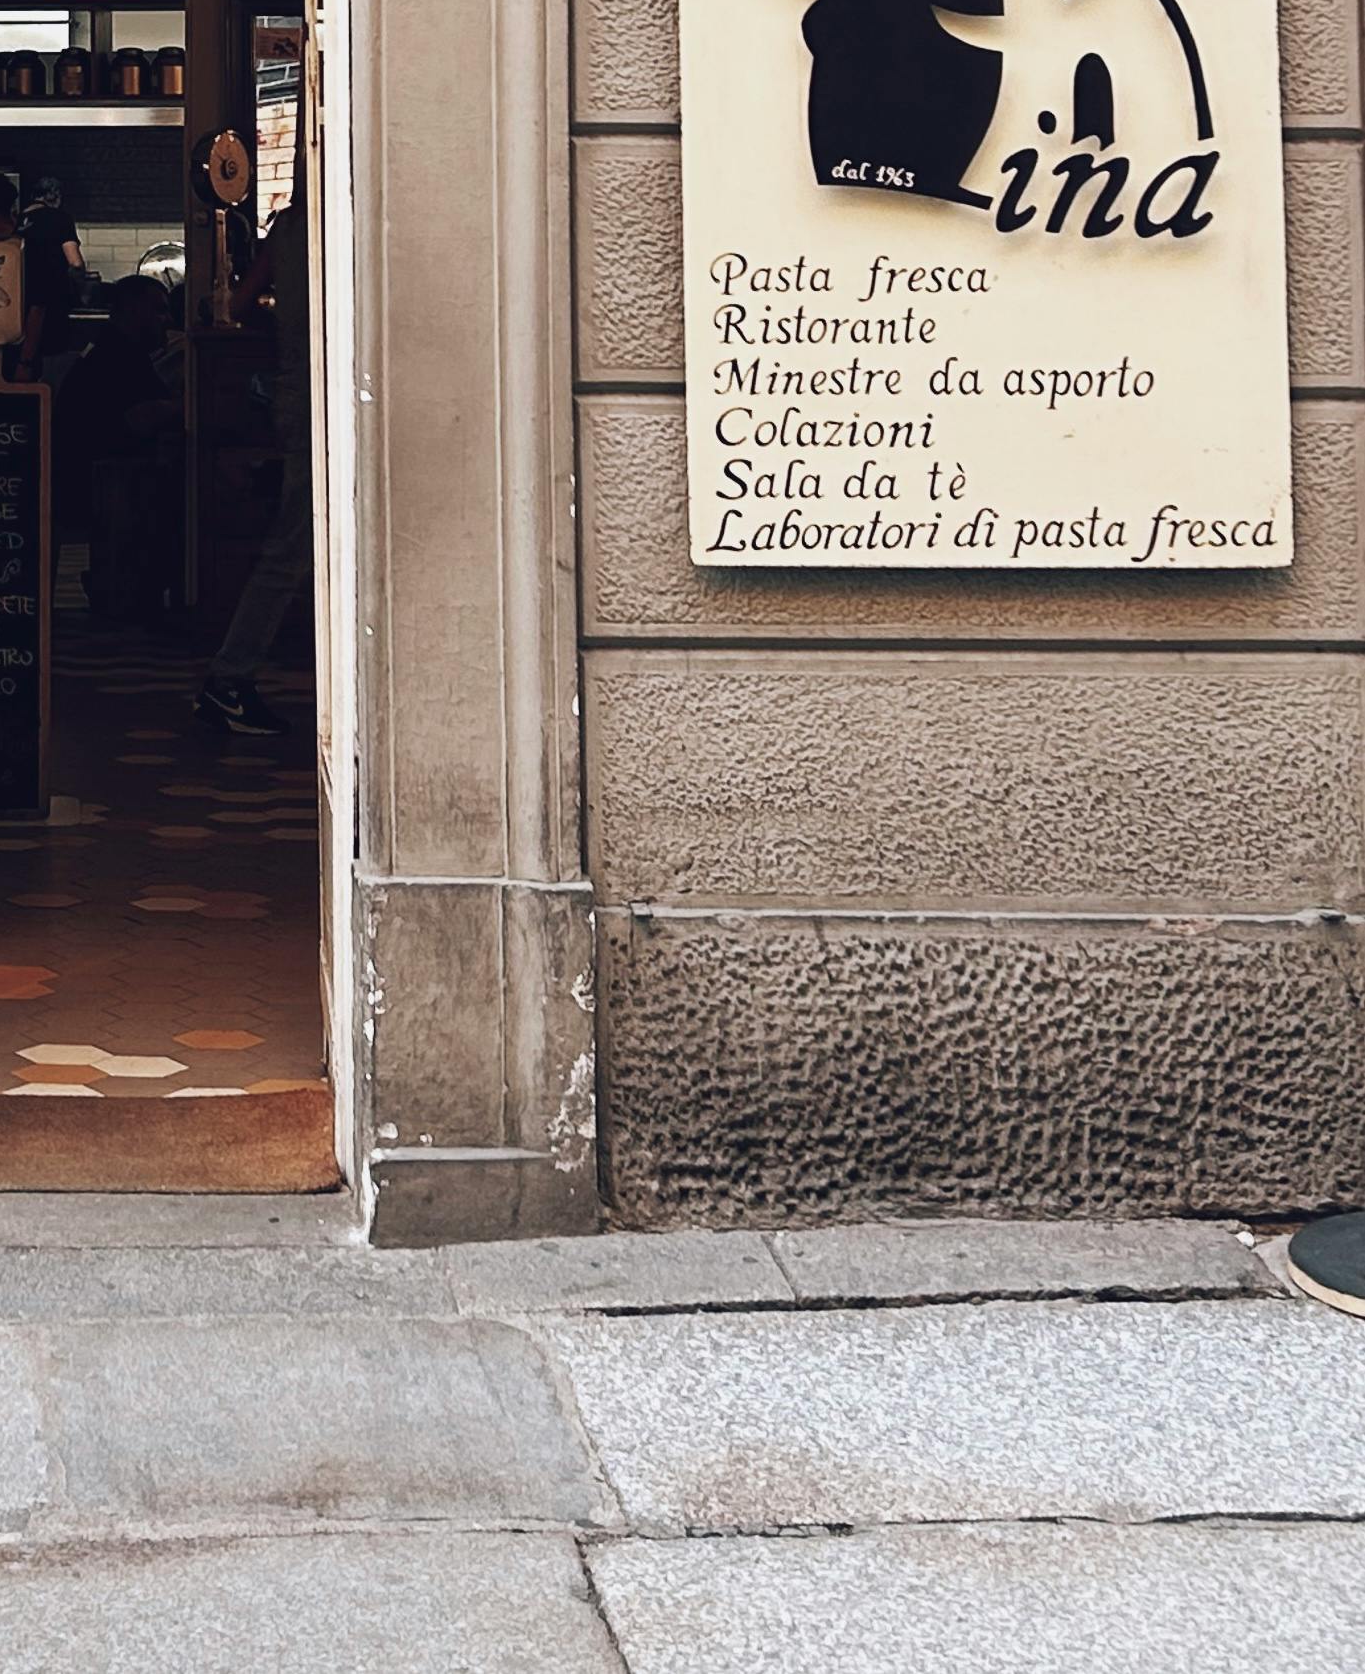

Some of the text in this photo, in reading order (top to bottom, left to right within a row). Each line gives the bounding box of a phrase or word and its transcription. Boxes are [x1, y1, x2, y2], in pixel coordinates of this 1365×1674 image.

[831, 158, 915, 187] dal 1963
[710, 252, 992, 302] Pasta fresca
[713, 303, 937, 345] Ristorante
[713, 356, 1155, 410] Minestre da asporto
[715, 406, 936, 448] Colazioni
[715, 458, 967, 501] Sala da tè
[705, 504, 1278, 562] Laboratori di pasta fresca
